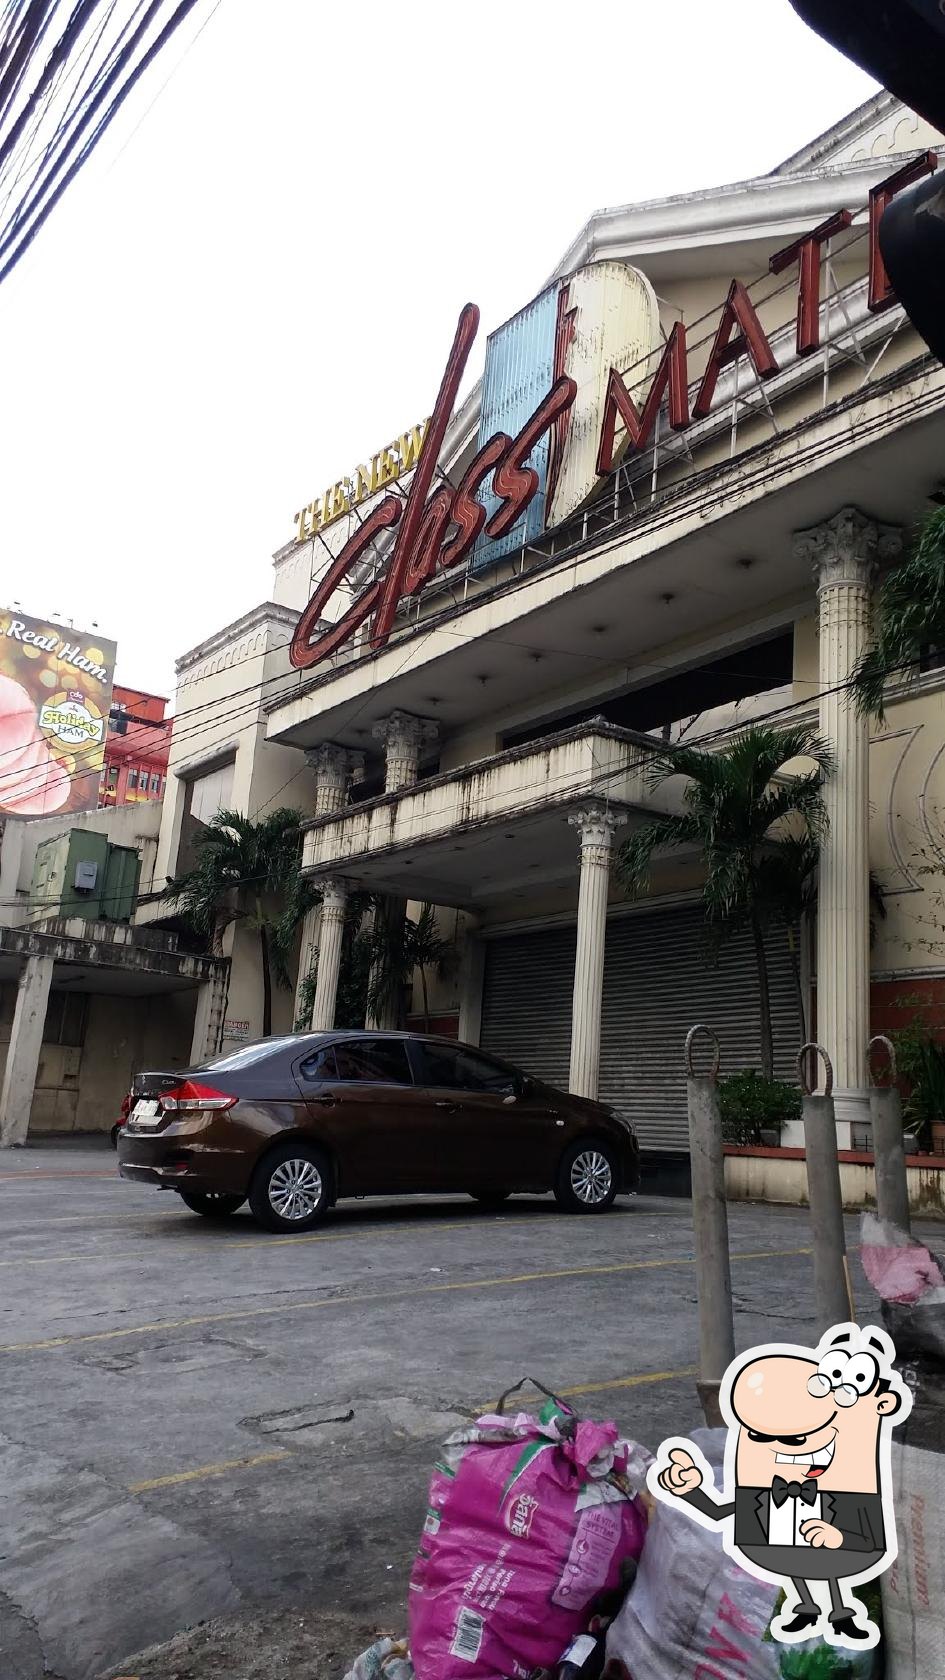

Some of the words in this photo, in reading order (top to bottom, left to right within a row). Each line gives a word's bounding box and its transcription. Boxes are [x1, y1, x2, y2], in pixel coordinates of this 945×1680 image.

[294, 476, 351, 546] THE
[354, 415, 434, 501] NEW
[6, 620, 60, 653] Real
[57, 642, 108, 684] Ham.
[42, 709, 100, 737] Holiday
[58, 725, 84, 738] HAM
